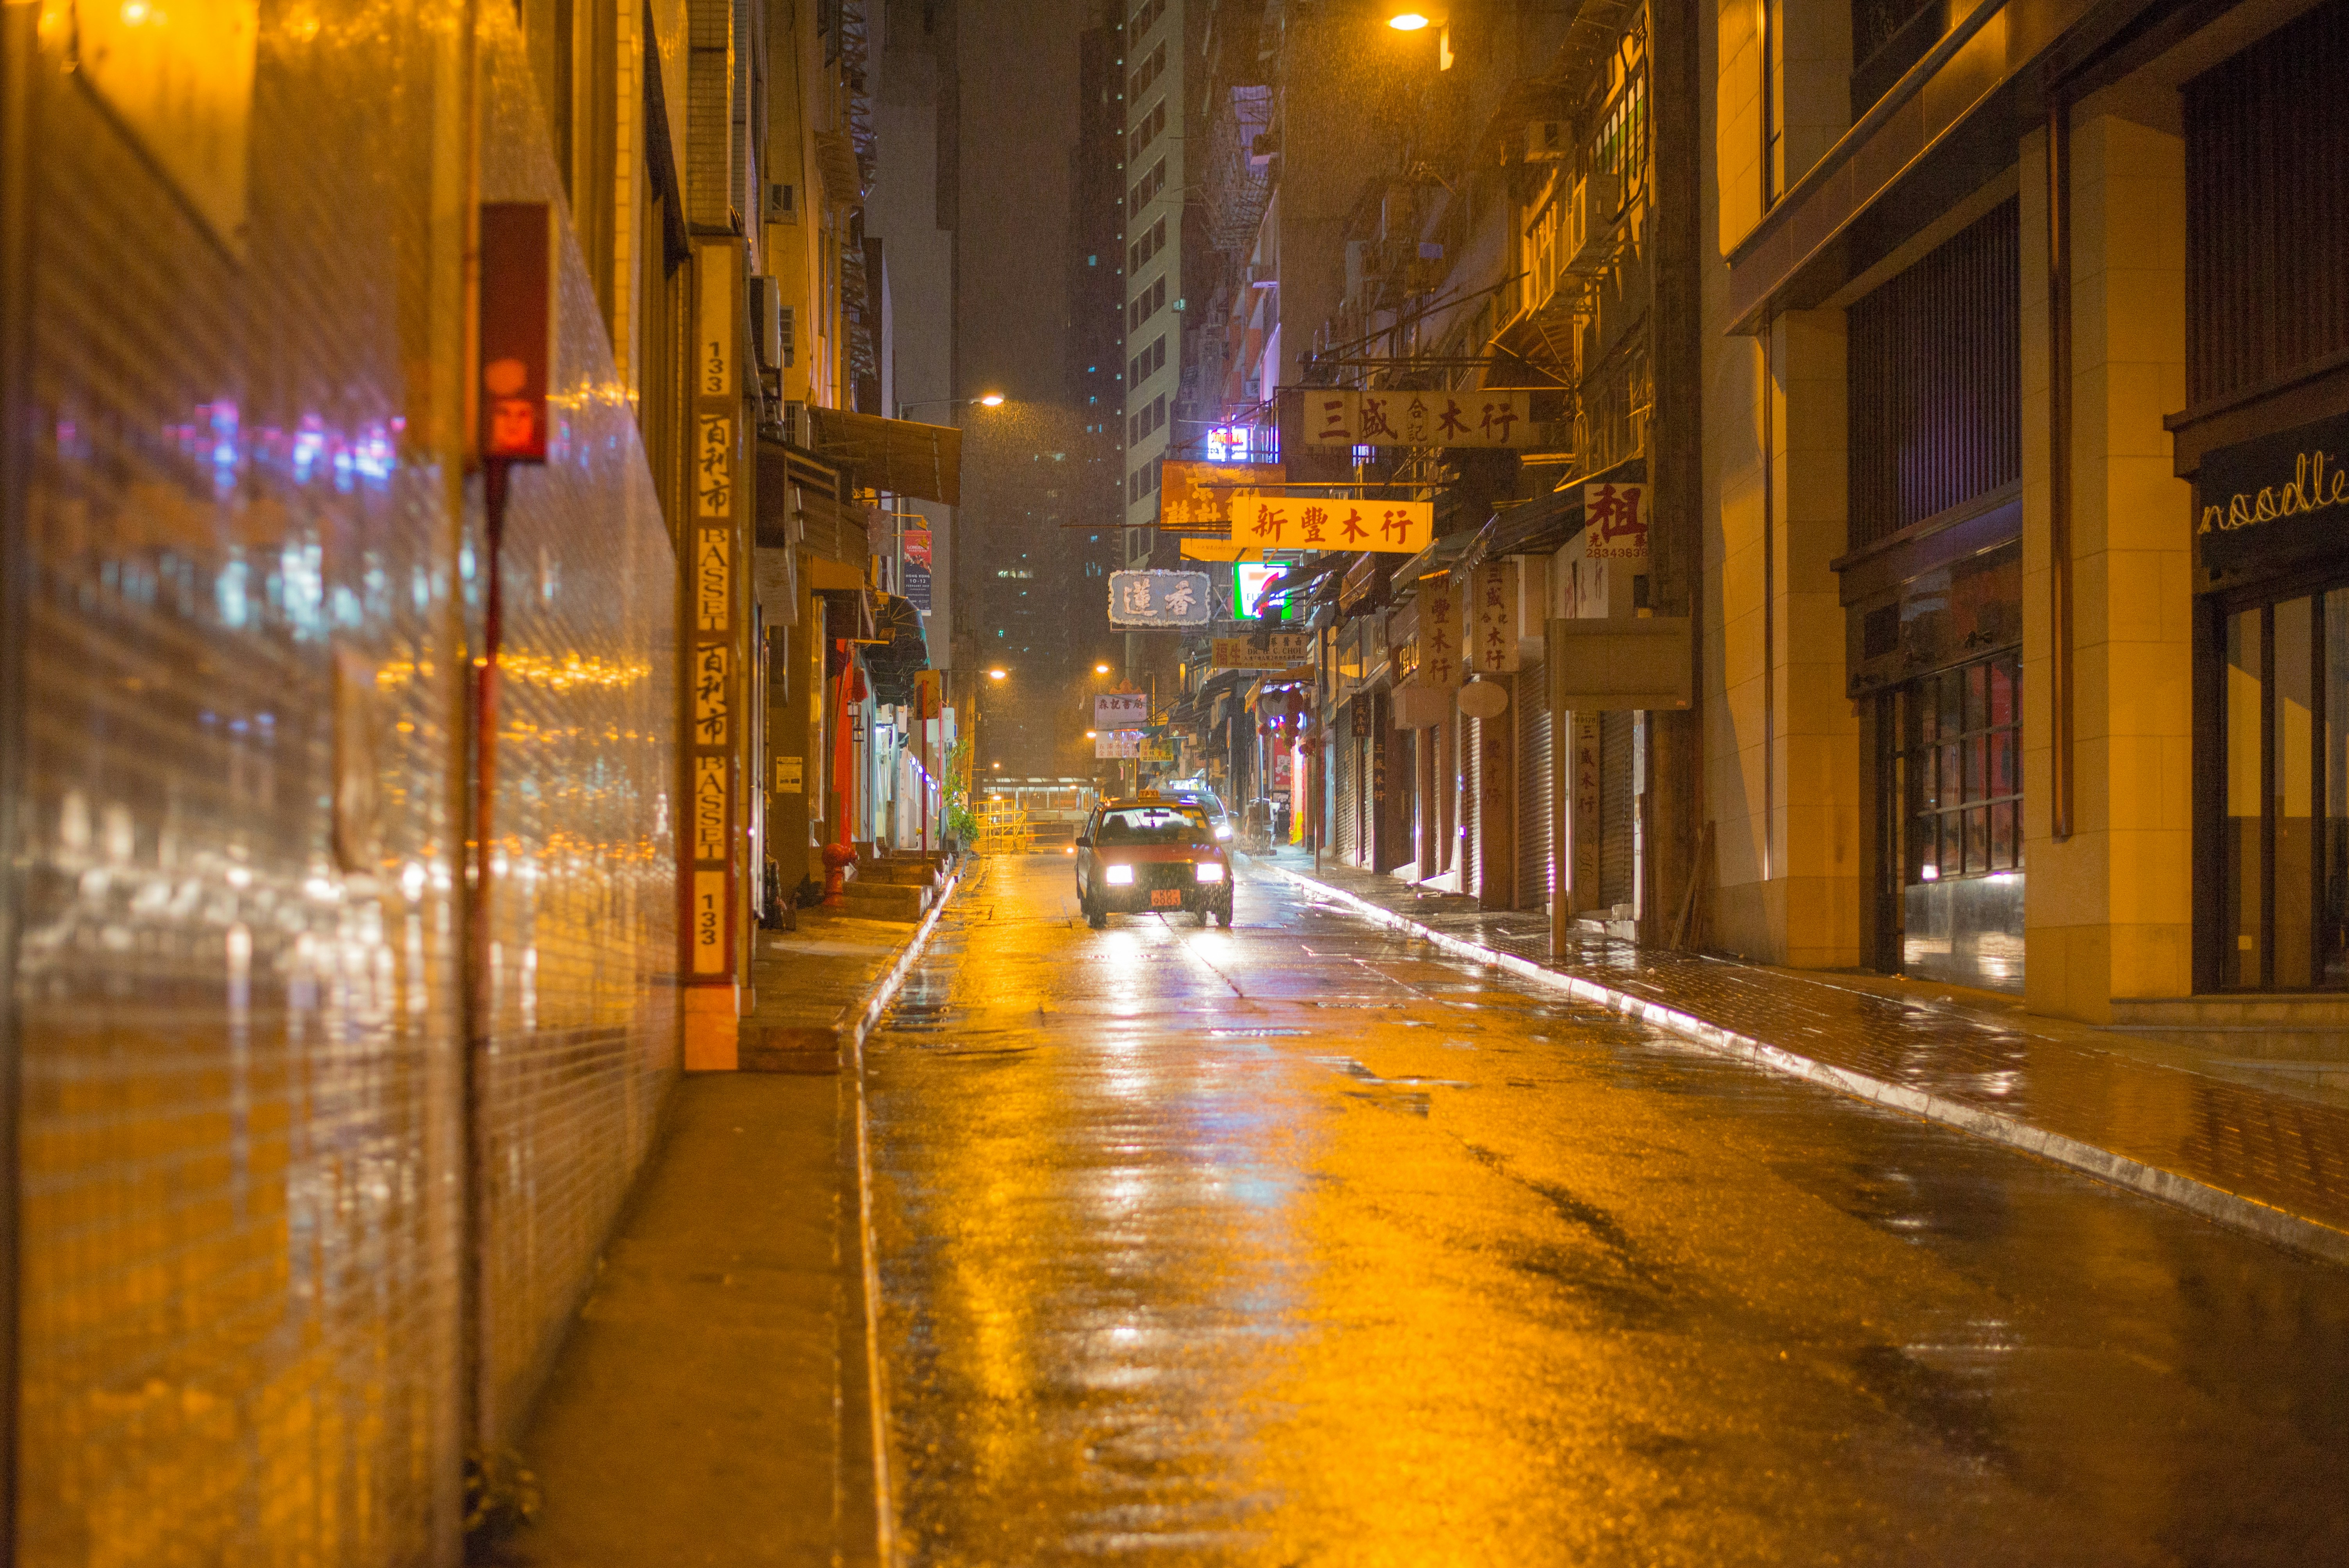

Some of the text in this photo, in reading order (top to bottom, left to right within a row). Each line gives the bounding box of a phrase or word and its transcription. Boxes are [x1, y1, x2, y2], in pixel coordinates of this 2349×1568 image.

[707, 342, 723, 392] 133
[1251, 503, 1413, 544] 新豐木行
[1586, 484, 1648, 543] 租
[701, 529, 727, 629] BASSET
[698, 757, 724, 859] BASSET
[701, 894, 716, 945] 133
